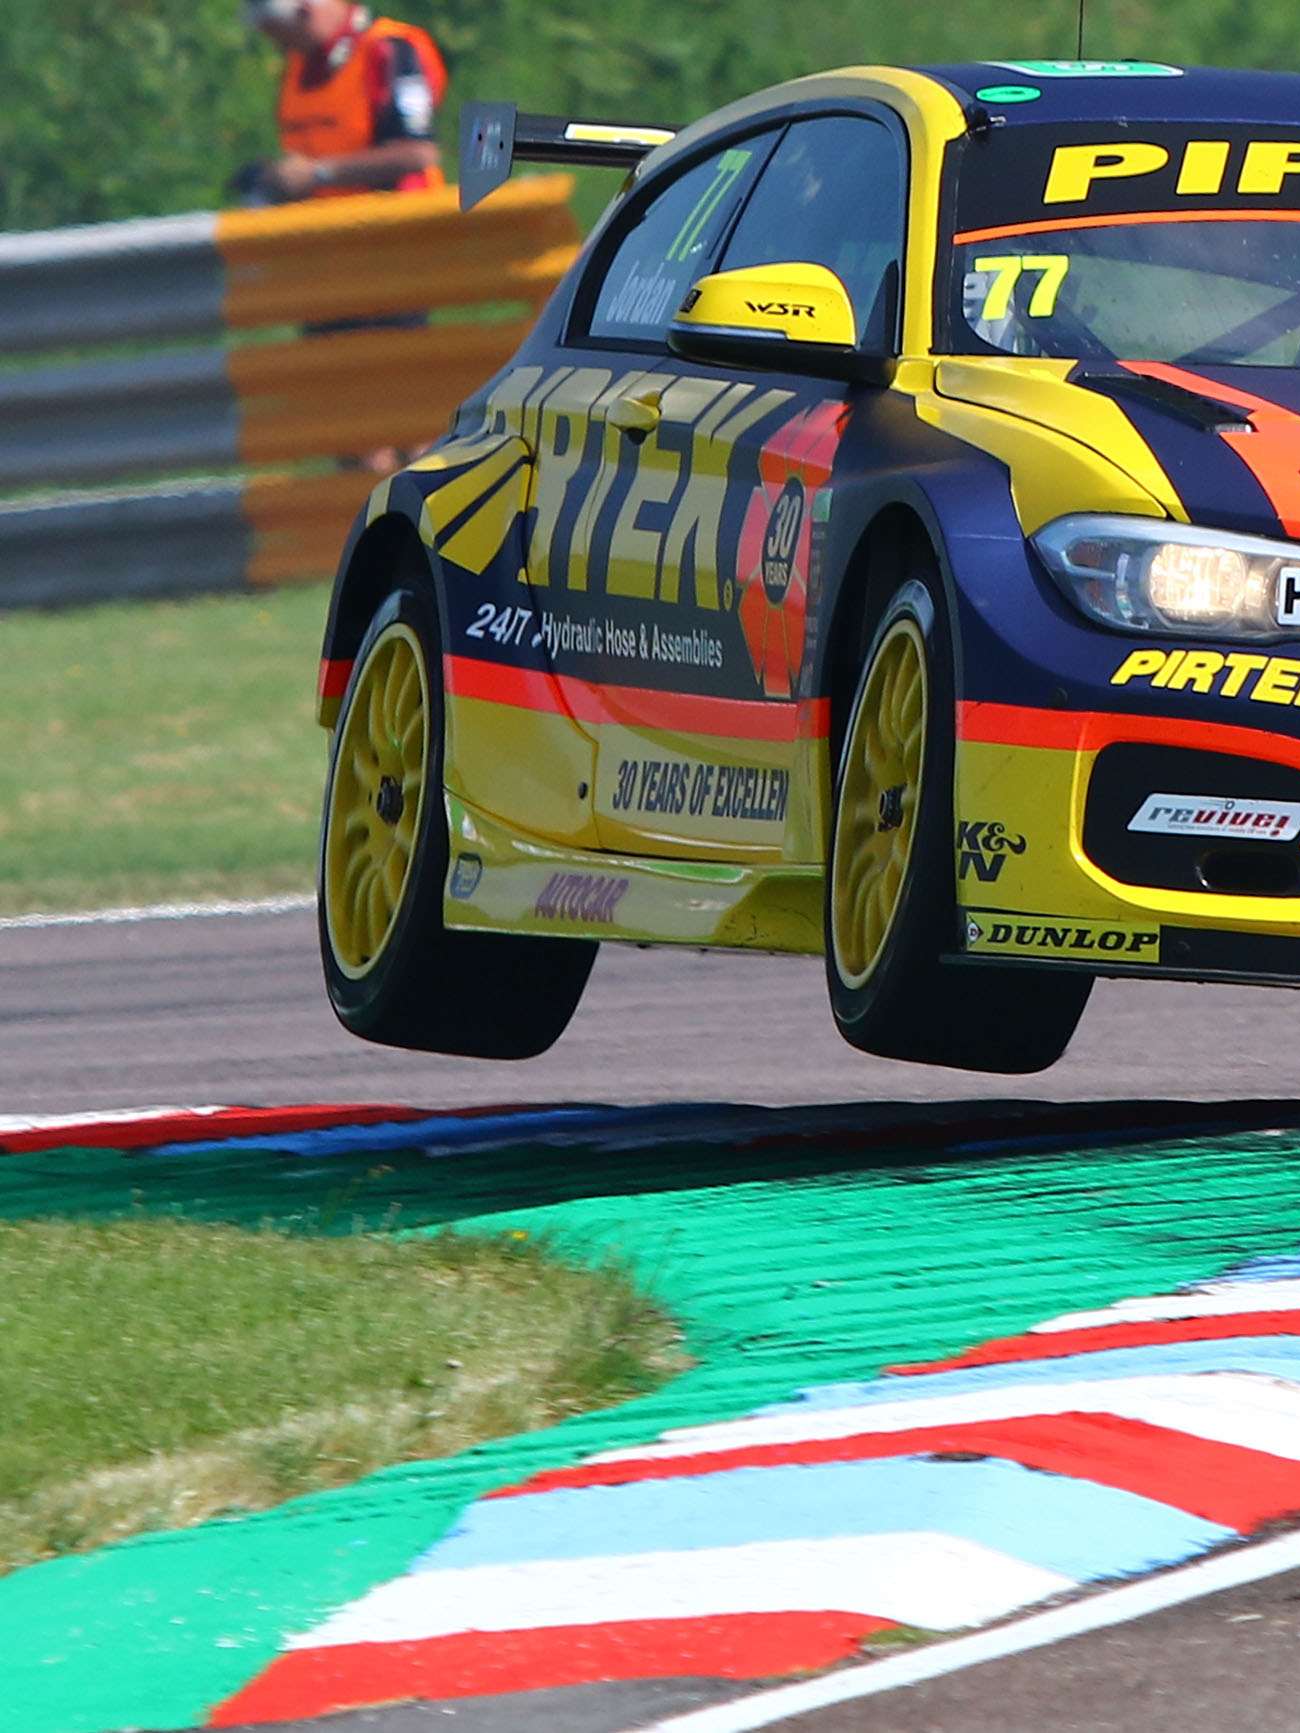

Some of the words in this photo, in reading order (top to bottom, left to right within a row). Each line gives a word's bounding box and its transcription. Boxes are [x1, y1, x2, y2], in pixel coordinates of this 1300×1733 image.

[744, 301, 816, 318] WSR
[974, 254, 1069, 321] 77
[767, 494, 802, 558] 30
[764, 560, 789, 588] YEARS
[465, 602, 533, 647] 24/7
[605, 619, 637, 659] Hose
[639, 622, 650, 660] &
[651, 623, 723, 668] Assemblies
[612, 759, 638, 811] 30
[637, 761, 691, 816] YEARS
[689, 763, 714, 817] OF
[986, 923, 1159, 953] DUNLOP
